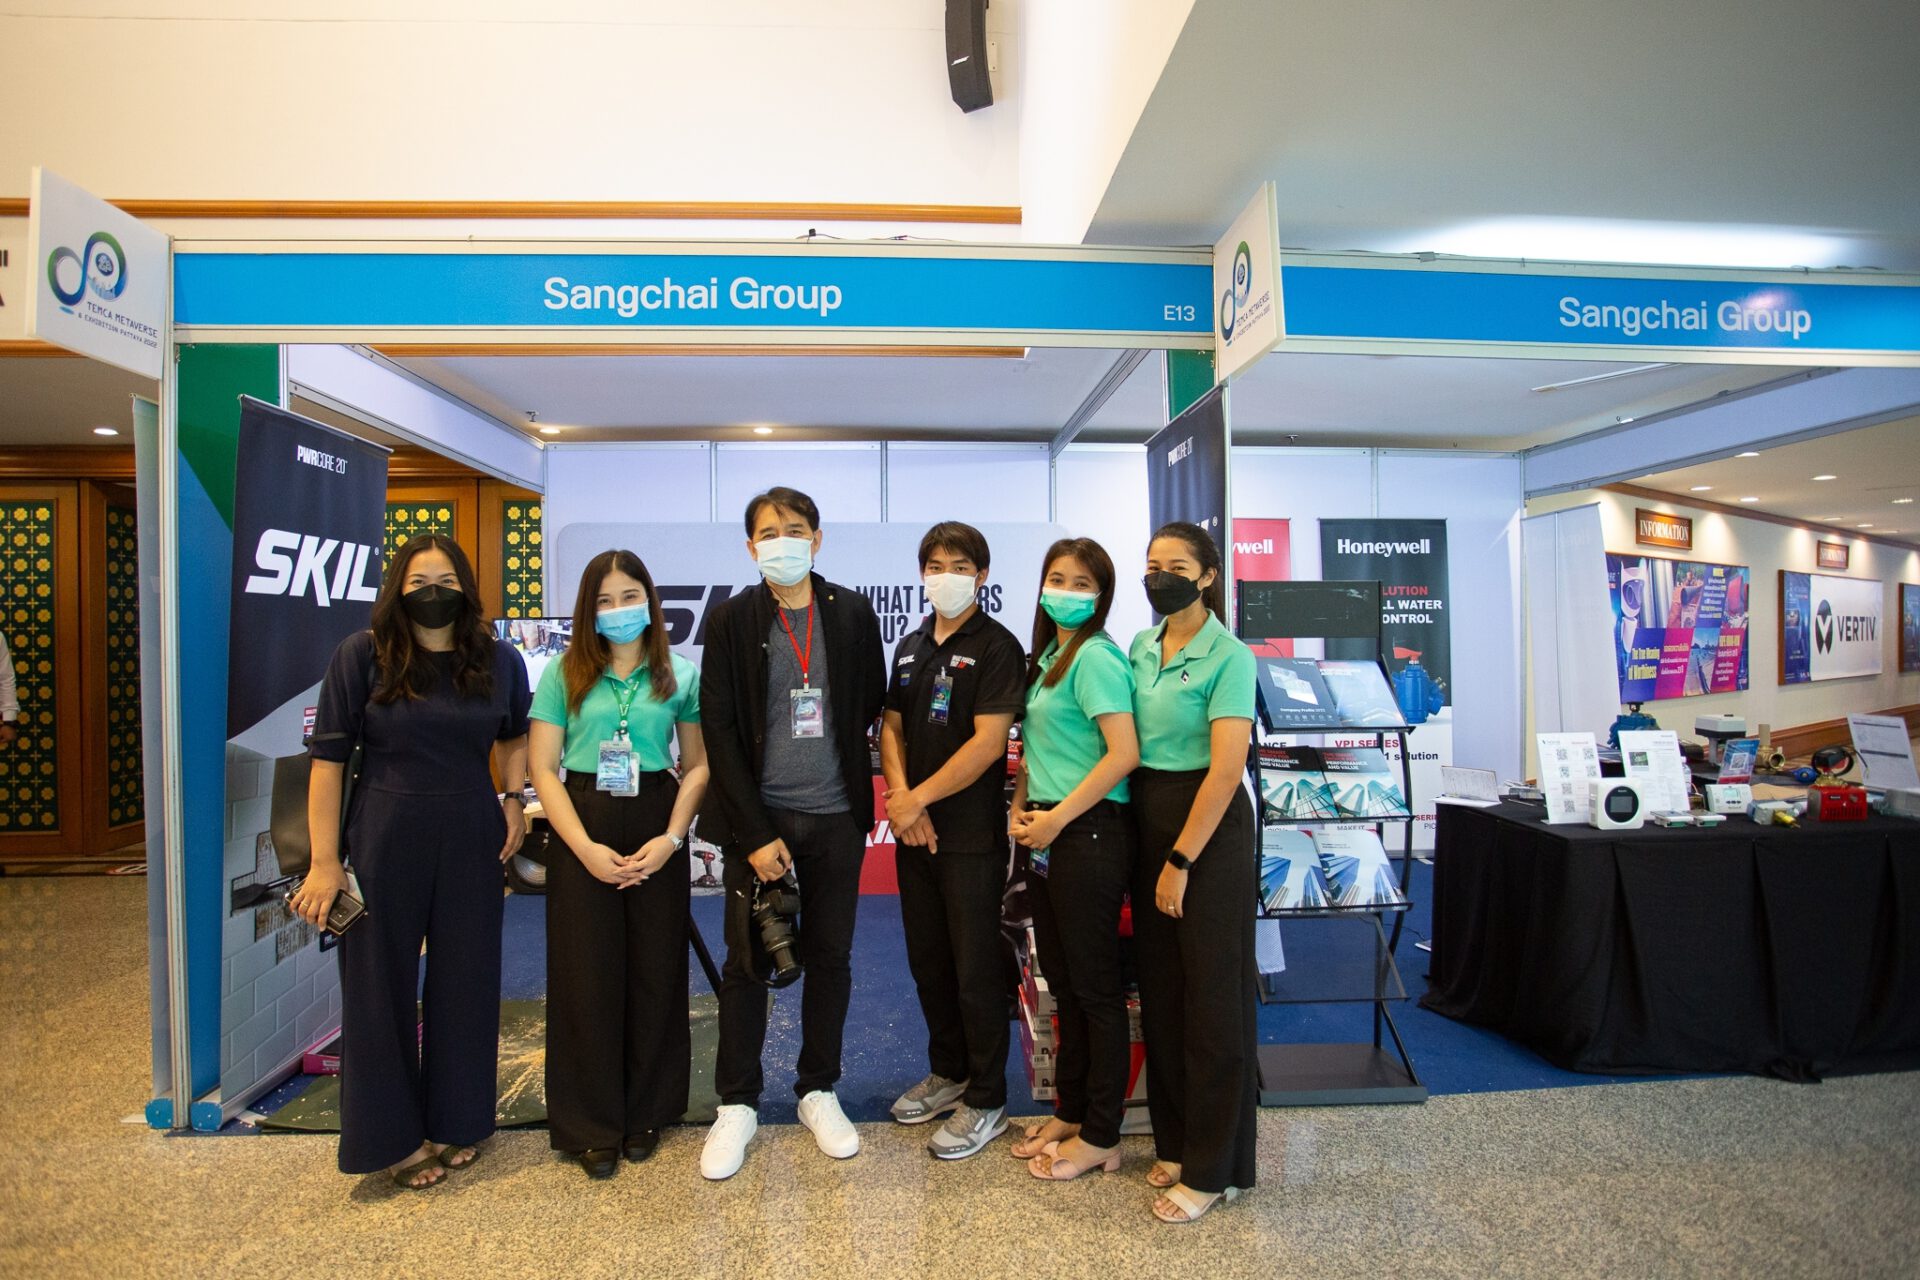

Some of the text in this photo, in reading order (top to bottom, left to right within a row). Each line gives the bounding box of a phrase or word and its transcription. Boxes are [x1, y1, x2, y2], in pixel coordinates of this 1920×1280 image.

[543, 276, 843, 317] Sangchai Group
[87, 301, 158, 338] TEMCA METAVERSE
[1163, 304, 1196, 322] E13
[1558, 296, 1812, 339] Sangchai Group
[297, 445, 335, 472] PWRCORE
[1639, 519, 1689, 541] INFORMATION
[1232, 539, 1274, 555] well
[1337, 538, 1431, 558] Honeywell
[245, 528, 379, 607] SKIL
[856, 584, 1003, 614] WHAT PRS
[1382, 585, 1429, 596] LUTION
[1397, 599, 1443, 610] WATER
[1382, 613, 1434, 625] ONTROL
[1836, 615, 1877, 642] VERTIV
[1394, 751, 1439, 761] slution
